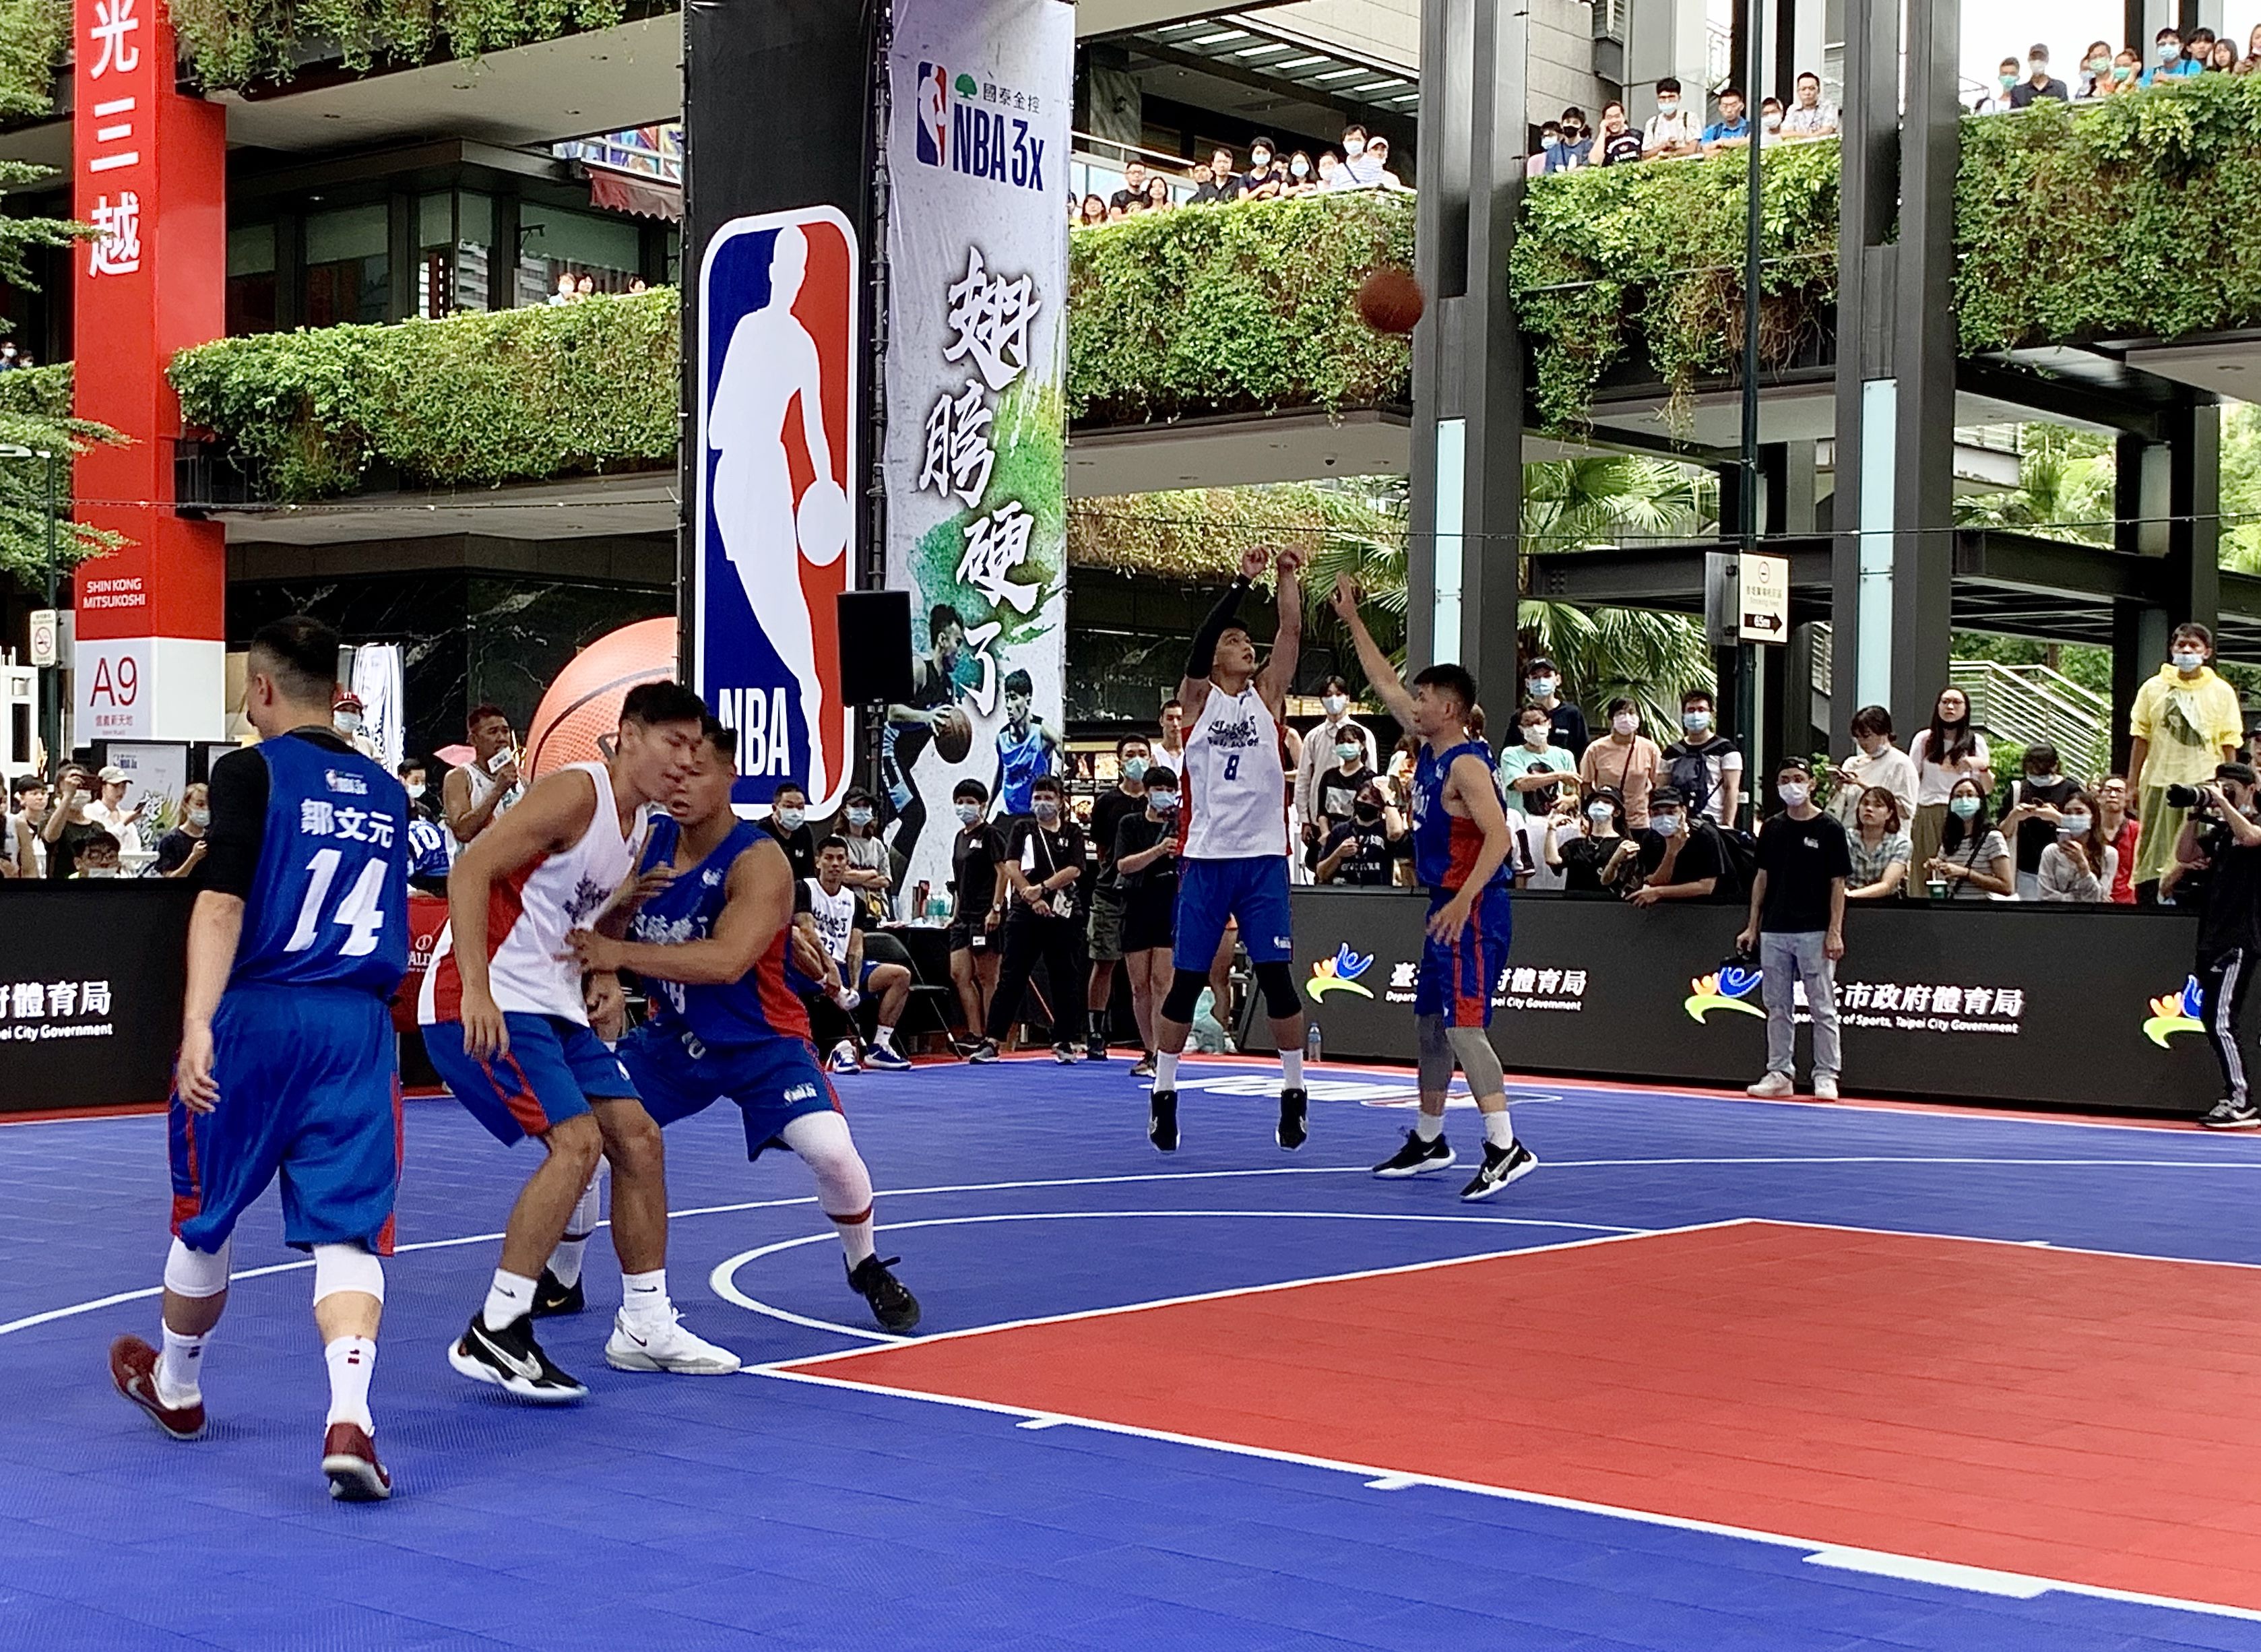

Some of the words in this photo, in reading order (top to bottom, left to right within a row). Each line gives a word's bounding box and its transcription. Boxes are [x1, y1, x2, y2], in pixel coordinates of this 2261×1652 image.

[983, 82, 1041, 115] 國泰金控
[953, 102, 1007, 183] NBA
[86, 579, 112, 594] SHIN
[112, 577, 142, 592] KONG
[82, 593, 146, 608] MITSUKOSHI
[90, 656, 137, 707] A9
[718, 687, 791, 776] NBA
[1223, 755, 1240, 780] 8
[283, 848, 389, 956] 14
[1525, 997, 1582, 1011] Government
[13, 1025, 39, 1042] City
[40, 1023, 113, 1039] Government
[1895, 1016, 1926, 1030] Taipei
[1927, 1018, 1949, 1032] City
[1950, 1019, 2020, 1034] Government
